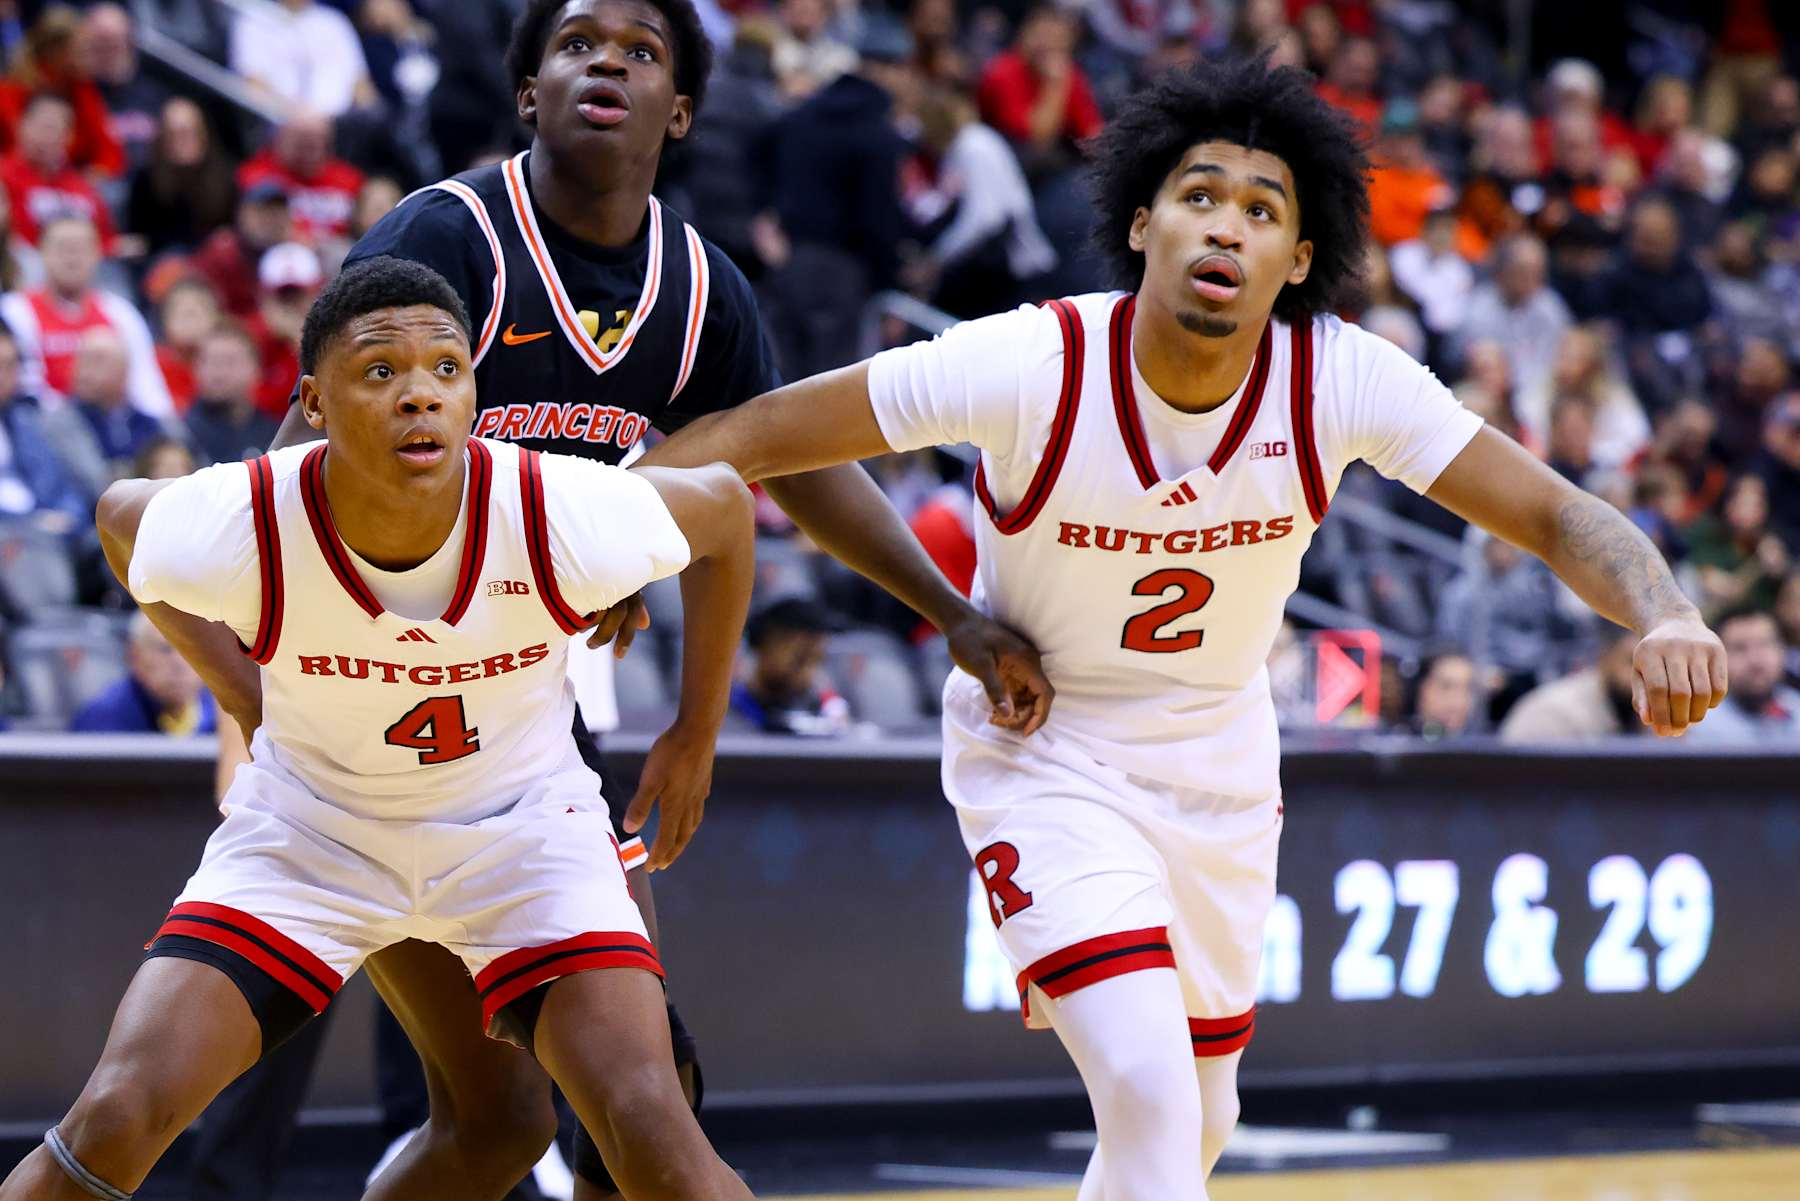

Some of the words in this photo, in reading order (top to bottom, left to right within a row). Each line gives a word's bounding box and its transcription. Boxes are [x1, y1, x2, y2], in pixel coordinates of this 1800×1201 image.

[1058, 515, 1294, 554] RUTGERS
[1120, 568, 1214, 653] 2
[298, 642, 550, 685] RUTGERS
[384, 694, 480, 765] 4
[974, 841, 1033, 929] R
[1331, 859, 1460, 1000] 27
[1483, 852, 1563, 998] &
[1584, 852, 1714, 993] 29
